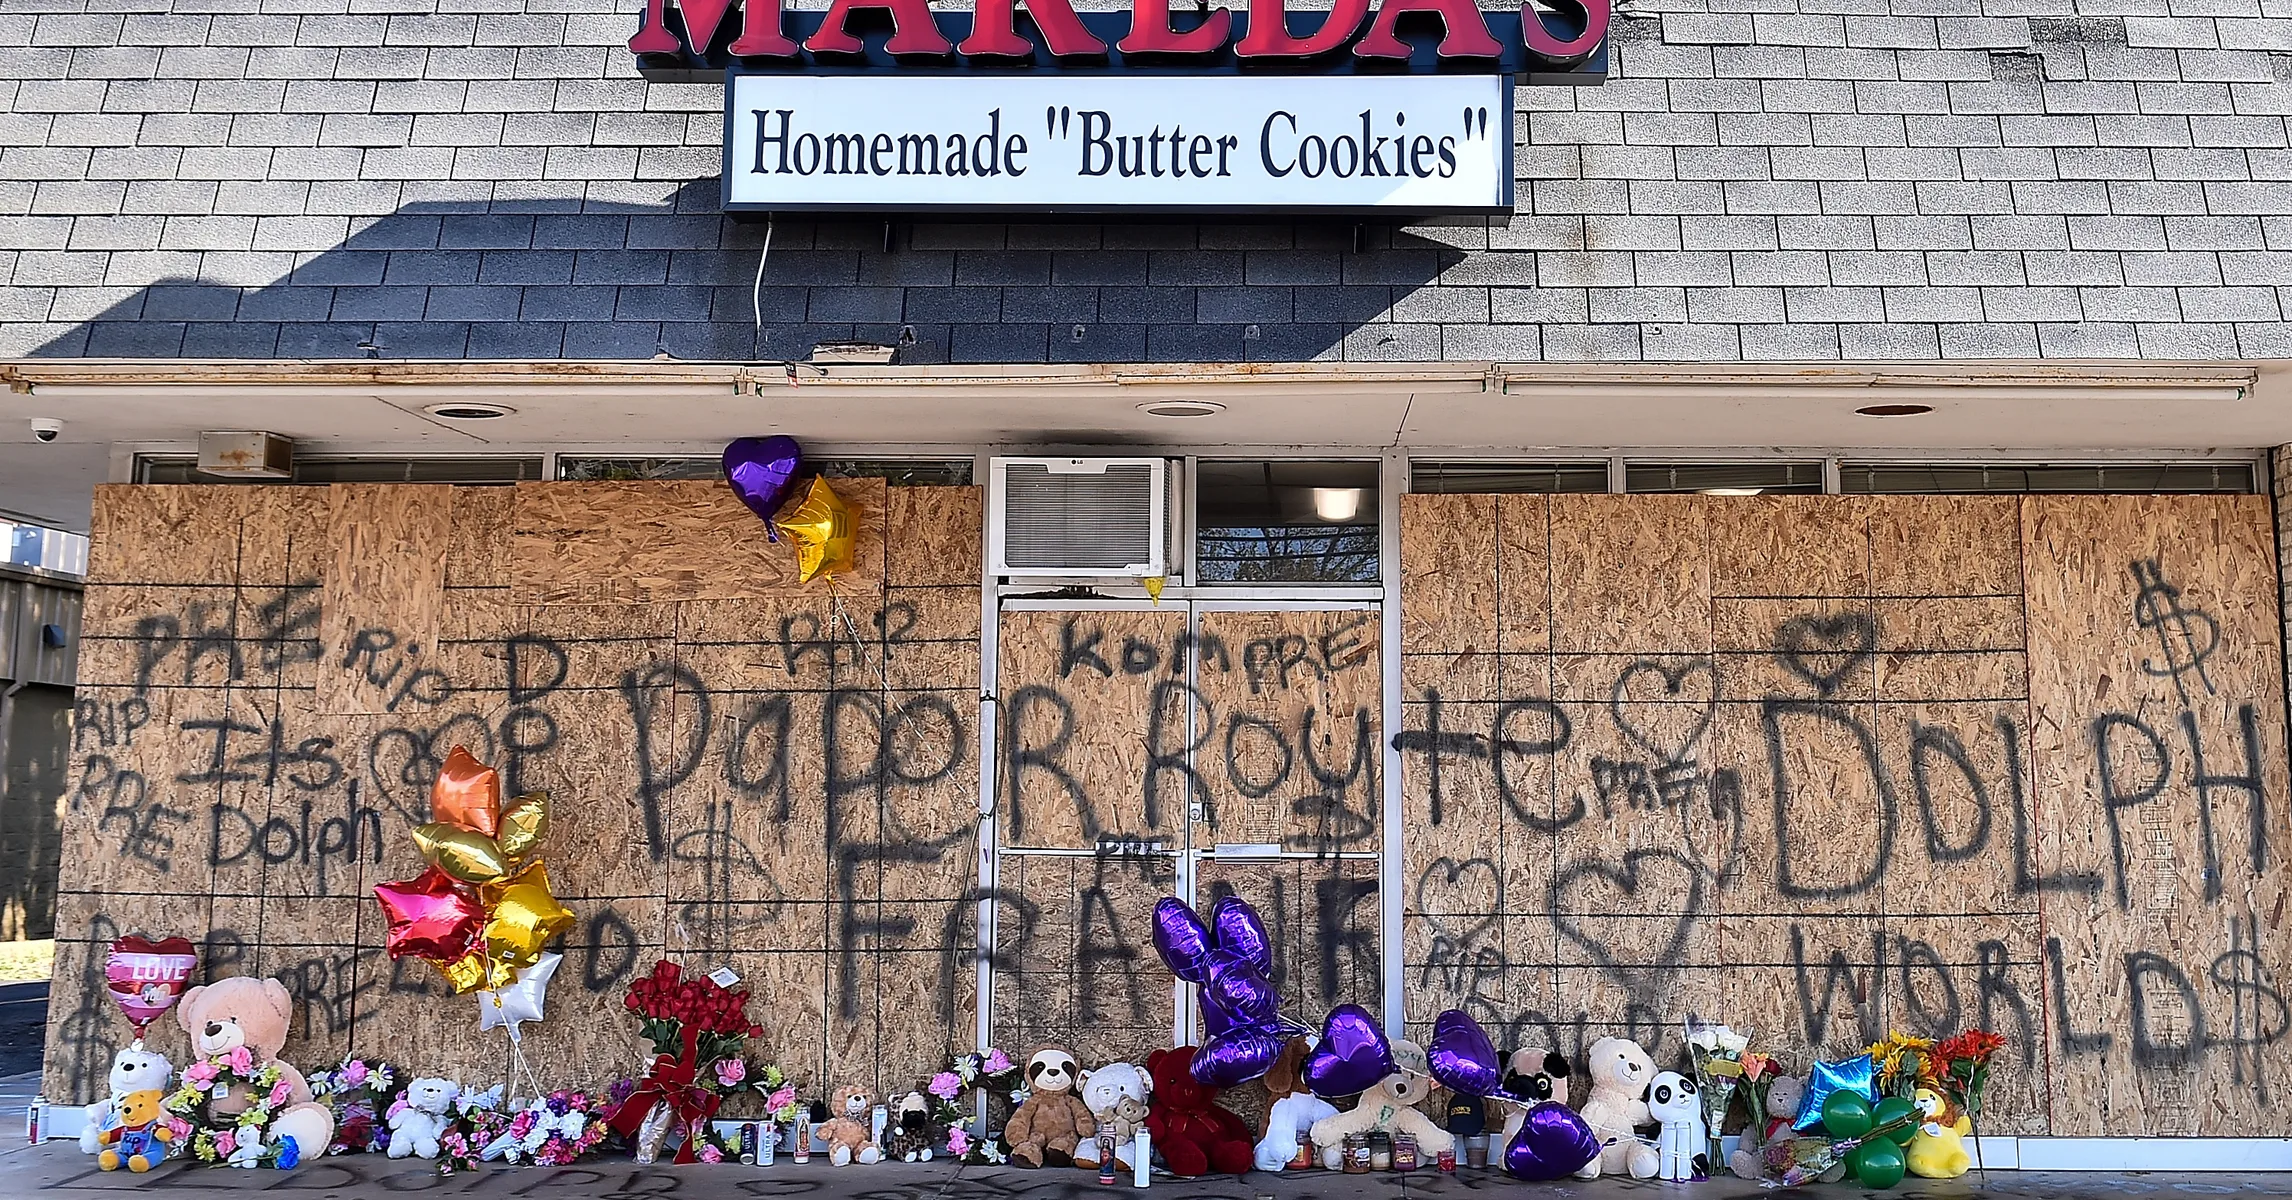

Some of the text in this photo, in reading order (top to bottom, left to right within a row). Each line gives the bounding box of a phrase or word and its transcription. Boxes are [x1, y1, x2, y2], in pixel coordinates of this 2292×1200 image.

[750, 106, 1489, 180] Homemade "Butter Cookies"
[72, 697, 149, 751] RIP
[131, 956, 186, 981] LOVE
